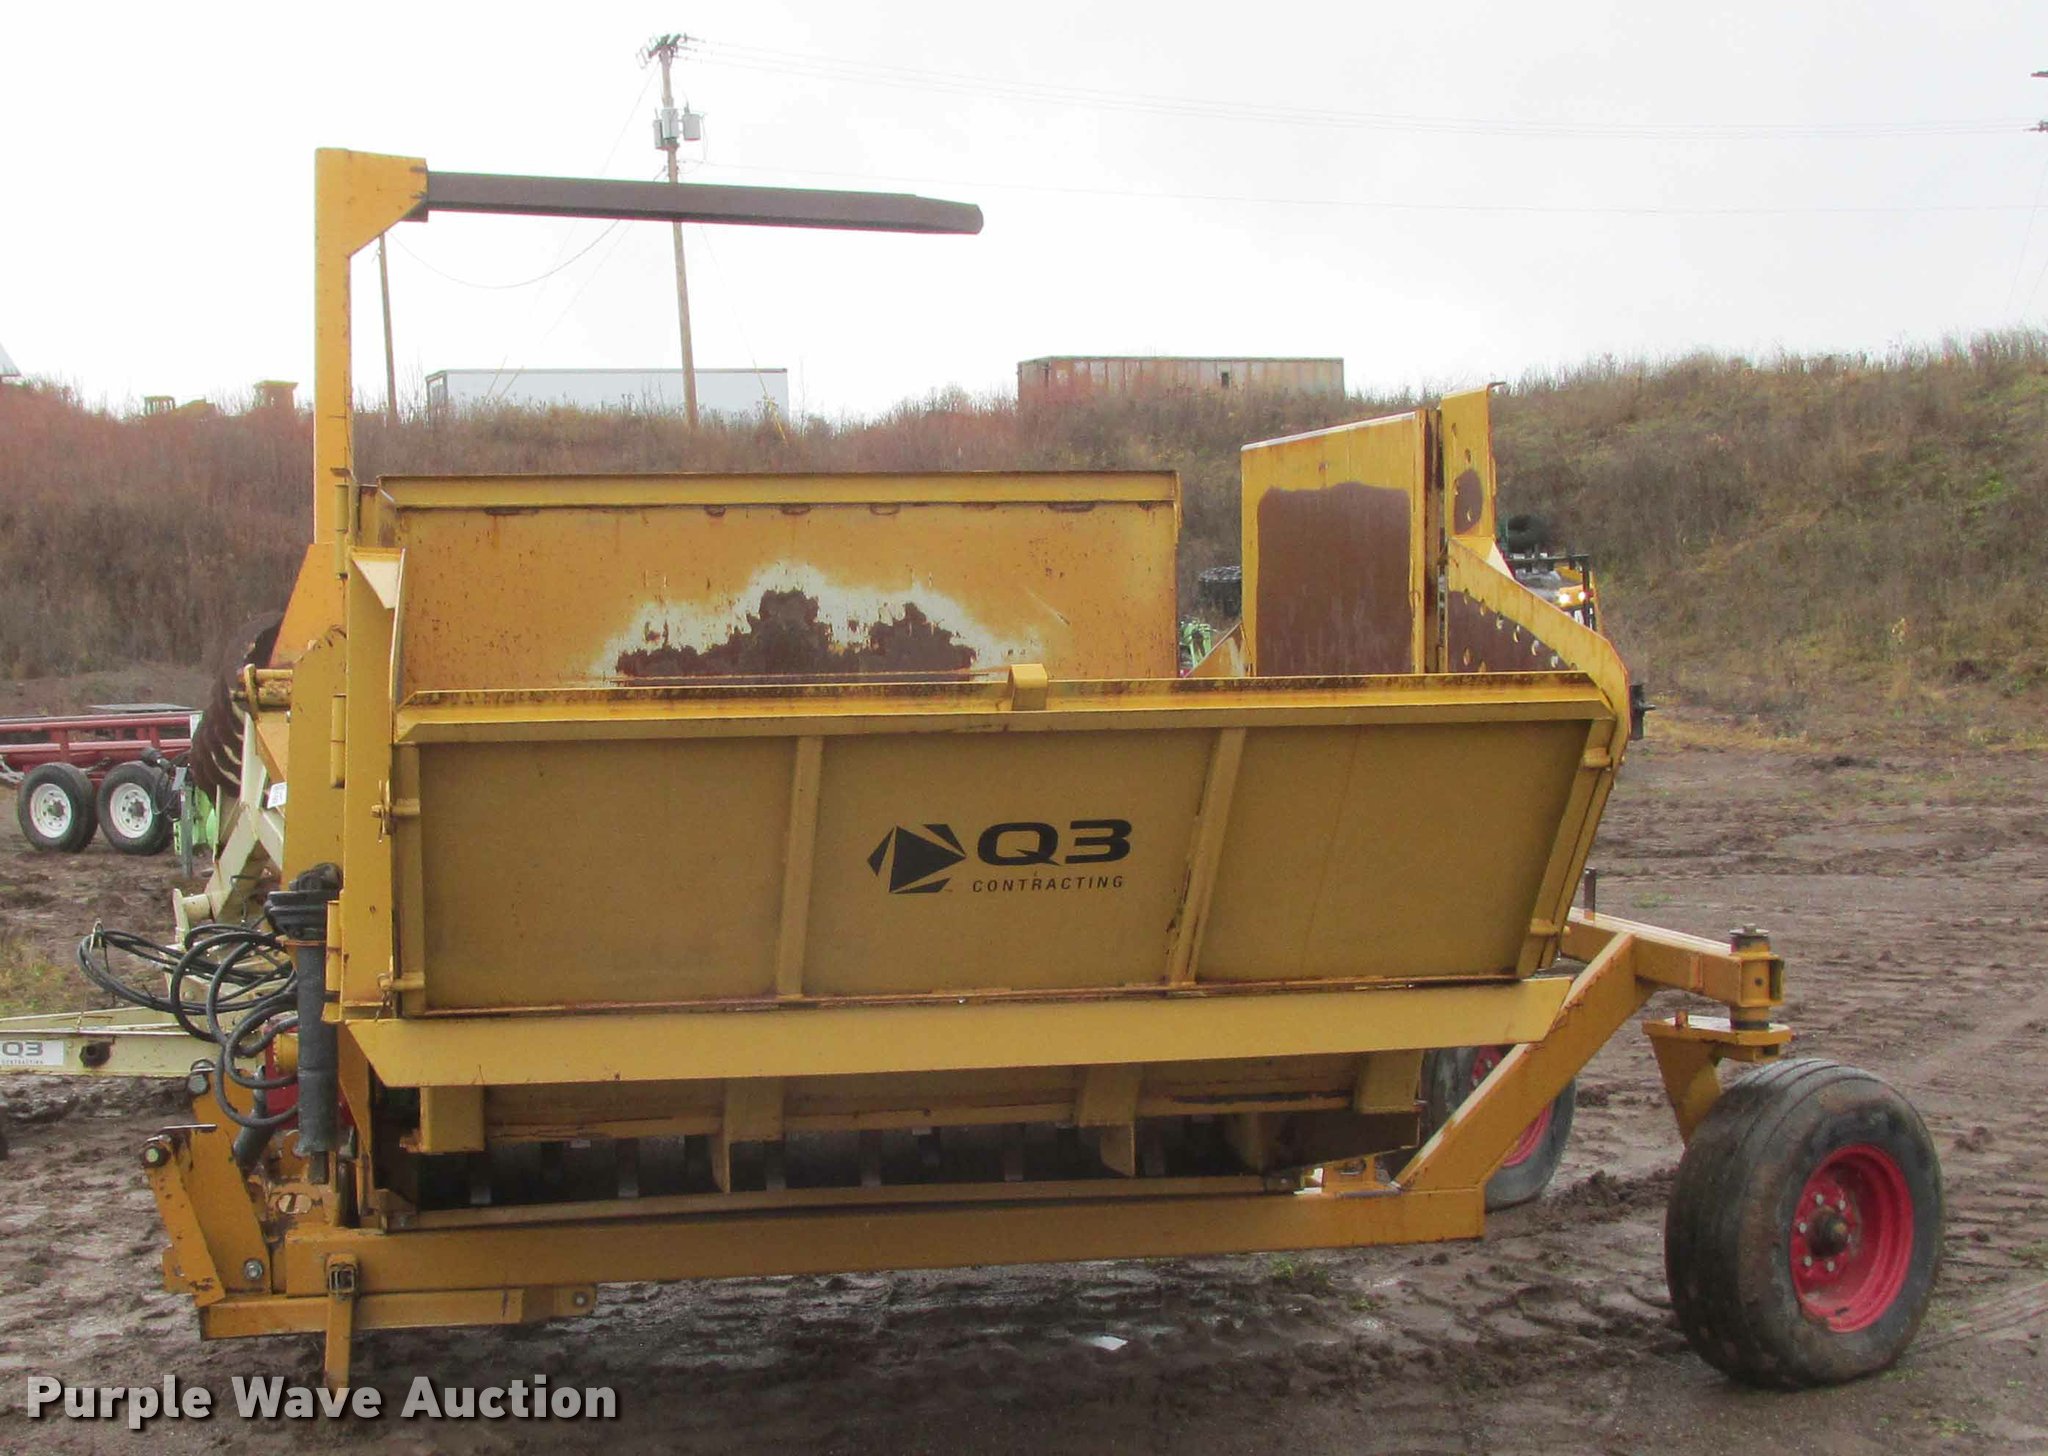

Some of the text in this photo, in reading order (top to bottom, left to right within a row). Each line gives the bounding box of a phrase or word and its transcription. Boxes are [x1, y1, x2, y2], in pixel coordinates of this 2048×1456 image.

[977, 819, 1132, 866] Q3
[972, 875, 1124, 893] CONTRACTING
[2, 1041, 44, 1058] Q3
